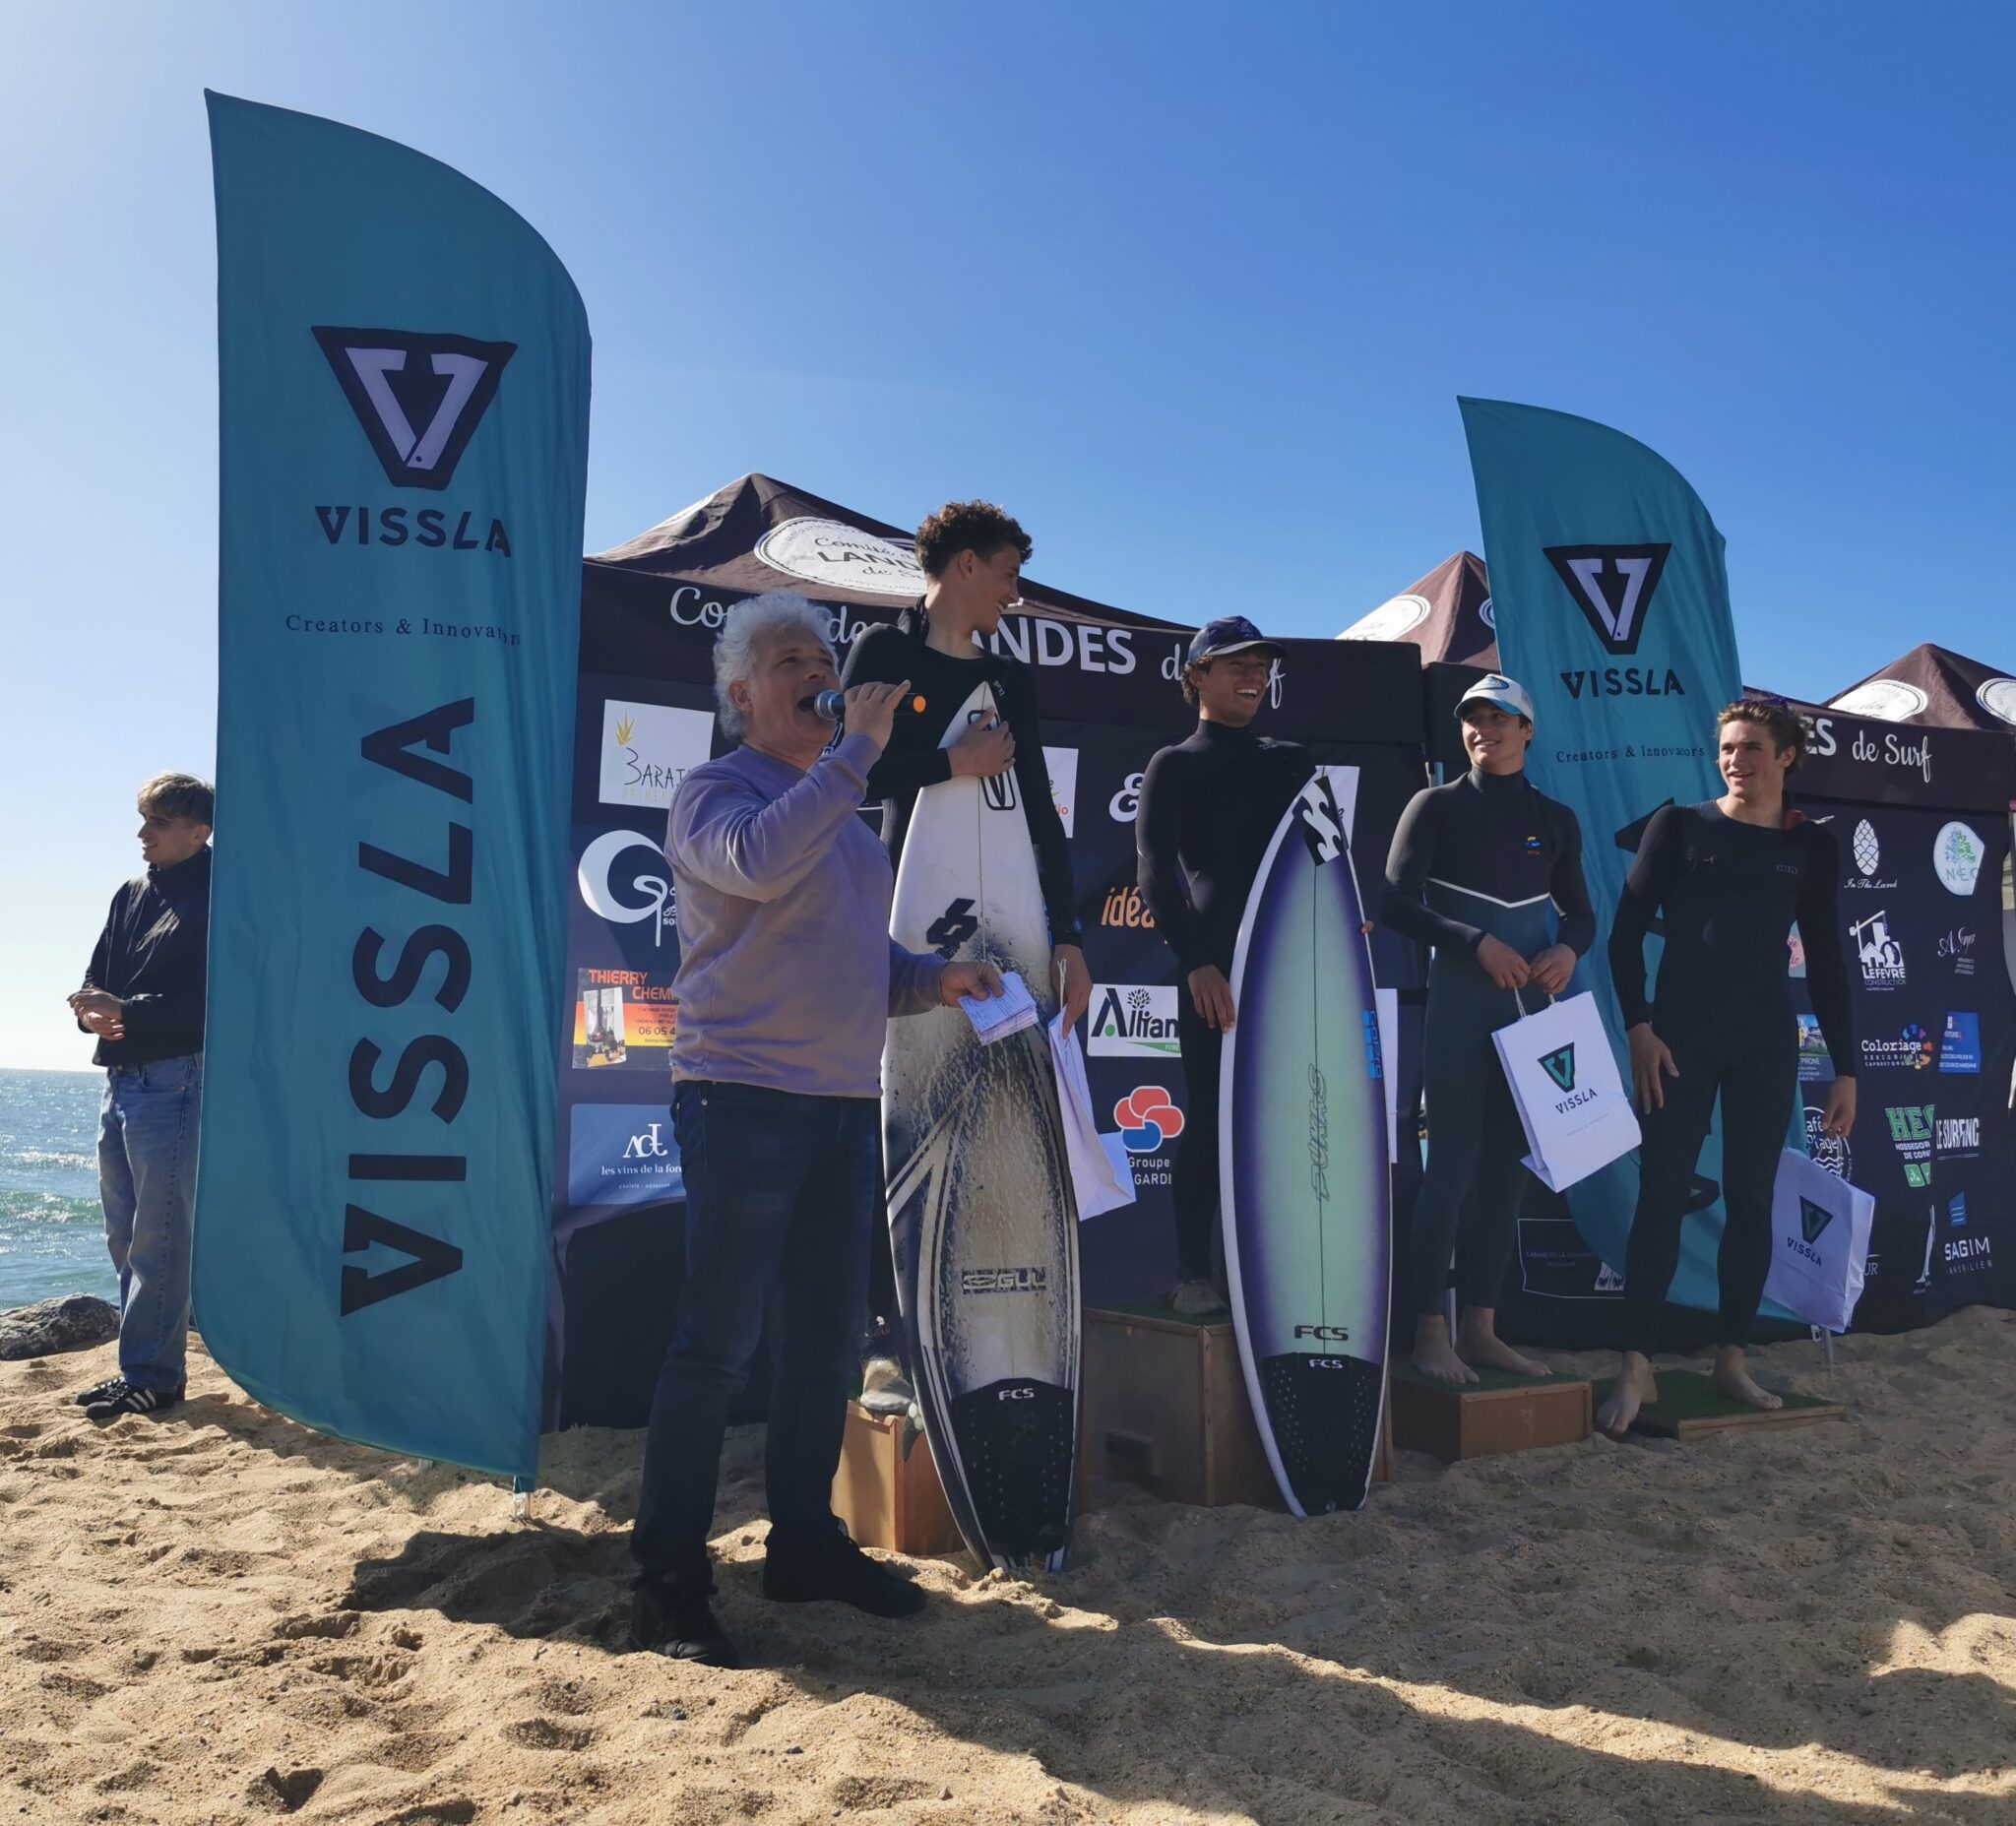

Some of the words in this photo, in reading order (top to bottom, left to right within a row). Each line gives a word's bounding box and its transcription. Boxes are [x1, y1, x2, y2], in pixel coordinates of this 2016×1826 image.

[314, 505, 512, 558] VISSLA
[816, 551, 923, 572] LAND
[285, 614, 385, 634] Creators
[396, 617, 412, 635] &
[972, 616, 1137, 675] NDES
[1559, 667, 1686, 700] VISSLA
[1555, 748, 1618, 764] Creators
[1625, 745, 1635, 758] &
[1852, 729, 1879, 762] de
[1884, 733, 1932, 784] Surf
[1872, 878, 1898, 889] Land
[588, 969, 649, 985] THIERRY
[1861, 965, 1906, 979] LEFEVRE
[341, 696, 474, 1318] VISSLA
[638, 1026, 652, 1036] 06
[654, 1026, 667, 1036] 05
[1860, 1039, 1922, 1054] Coloriage
[1555, 1088, 1598, 1114] VISSLA
[1805, 1115, 1824, 1132] afé
[600, 1165, 616, 1176] les
[617, 1165, 639, 1175] vins
[640, 1163, 653, 1173] de
[654, 1163, 663, 1173] la
[1128, 1156, 1171, 1170] Groupe
[1787, 1236, 1822, 1268] VISSLA
[1944, 1236, 1991, 1262] SAGIM
[1294, 1324, 1350, 1342] FCS
[1309, 1358, 1344, 1369] FCS
[998, 1388, 1035, 1402] FCS
